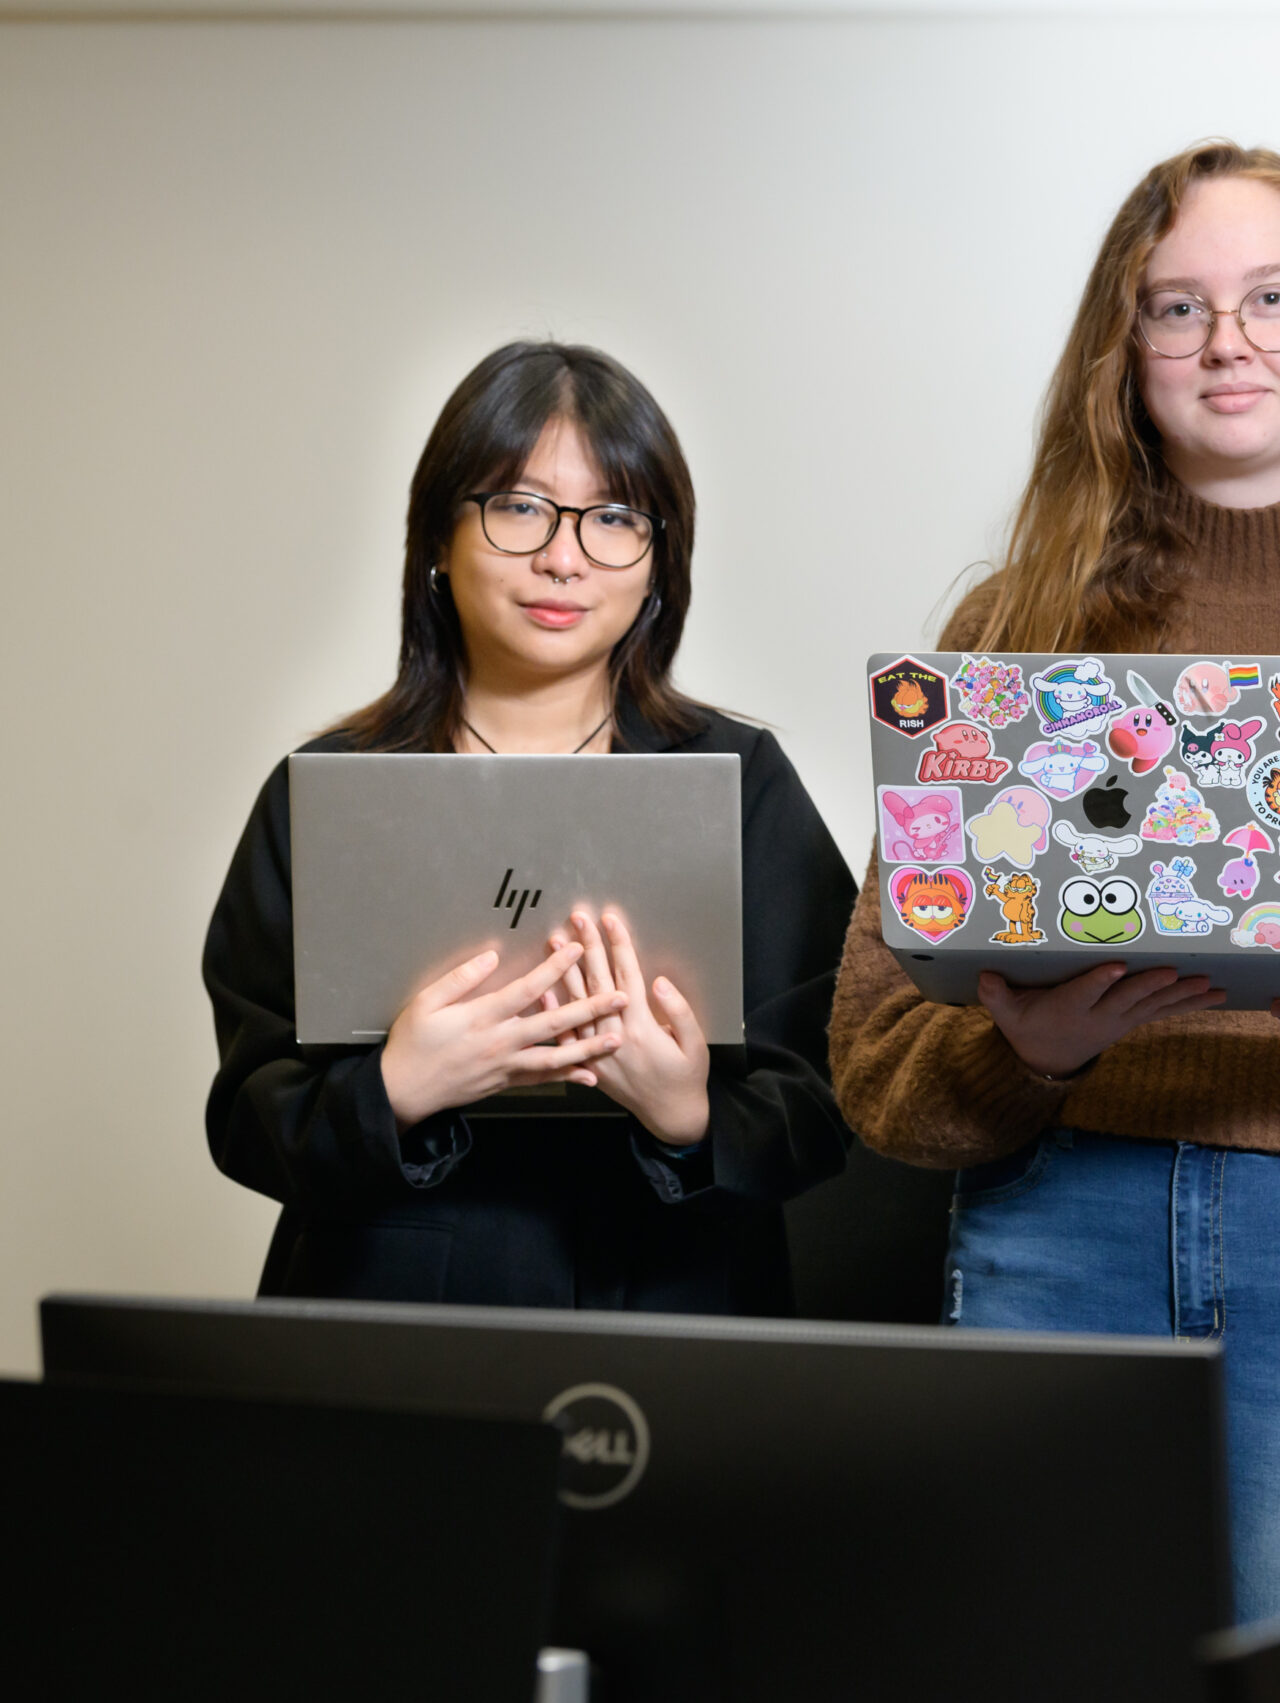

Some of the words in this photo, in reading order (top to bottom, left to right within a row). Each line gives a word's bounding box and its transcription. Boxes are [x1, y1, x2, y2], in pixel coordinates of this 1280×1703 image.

[878, 672, 905, 684] EAT
[909, 672, 937, 683] THE
[899, 719, 924, 728] RISH
[1042, 701, 1122, 734] CINNAMOROLL
[1252, 767, 1265, 785] YOU
[1263, 755, 1280, 769] ARE
[1255, 801, 1266, 814] TO
[493, 868, 542, 929] hp
